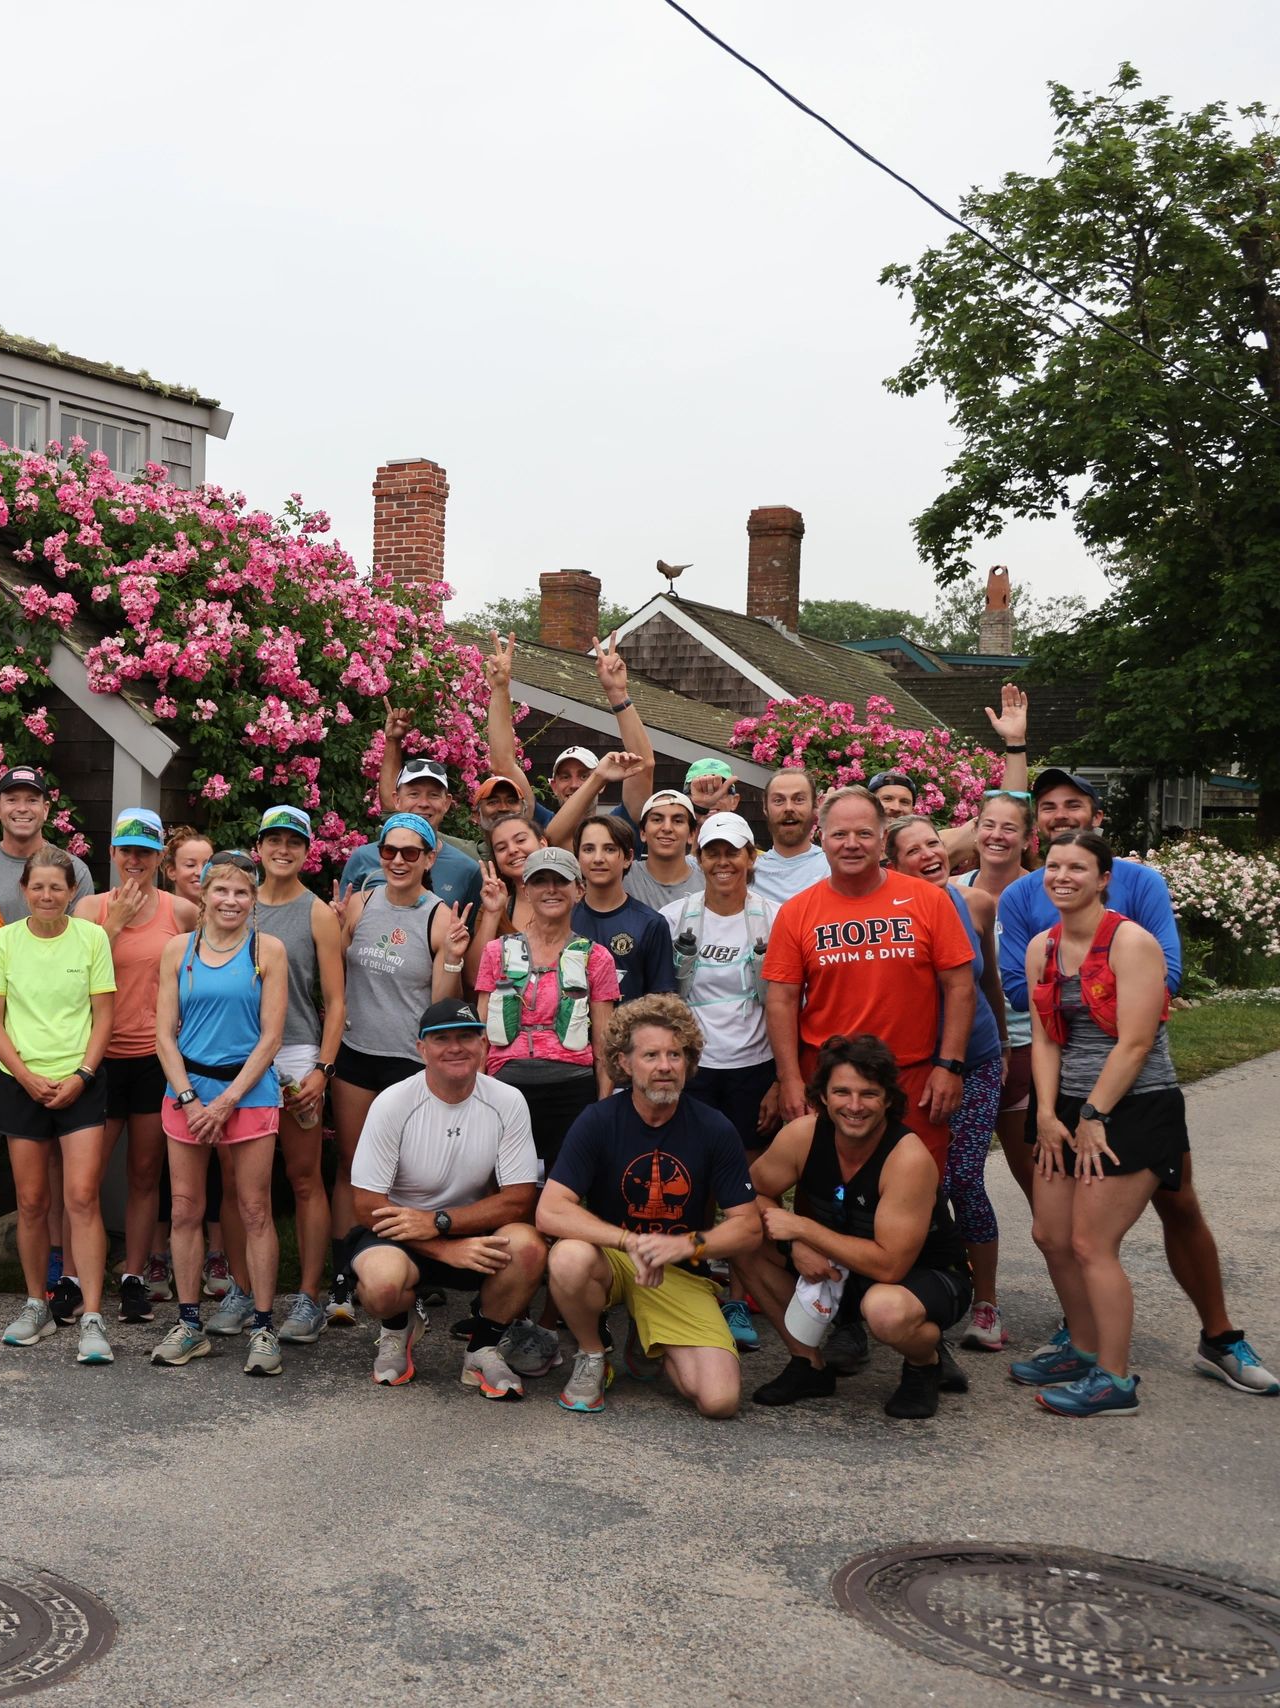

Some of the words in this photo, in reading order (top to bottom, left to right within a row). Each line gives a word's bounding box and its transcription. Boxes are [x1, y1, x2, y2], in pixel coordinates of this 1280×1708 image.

[814, 917, 915, 951] HOPE
[699, 945, 740, 962] UCF
[819, 952, 860, 966] SWIM
[865, 949, 875, 960] &
[880, 948, 915, 959] DIVE
[360, 959, 368, 967] LE
[370, 961, 396, 974] DELUGE
